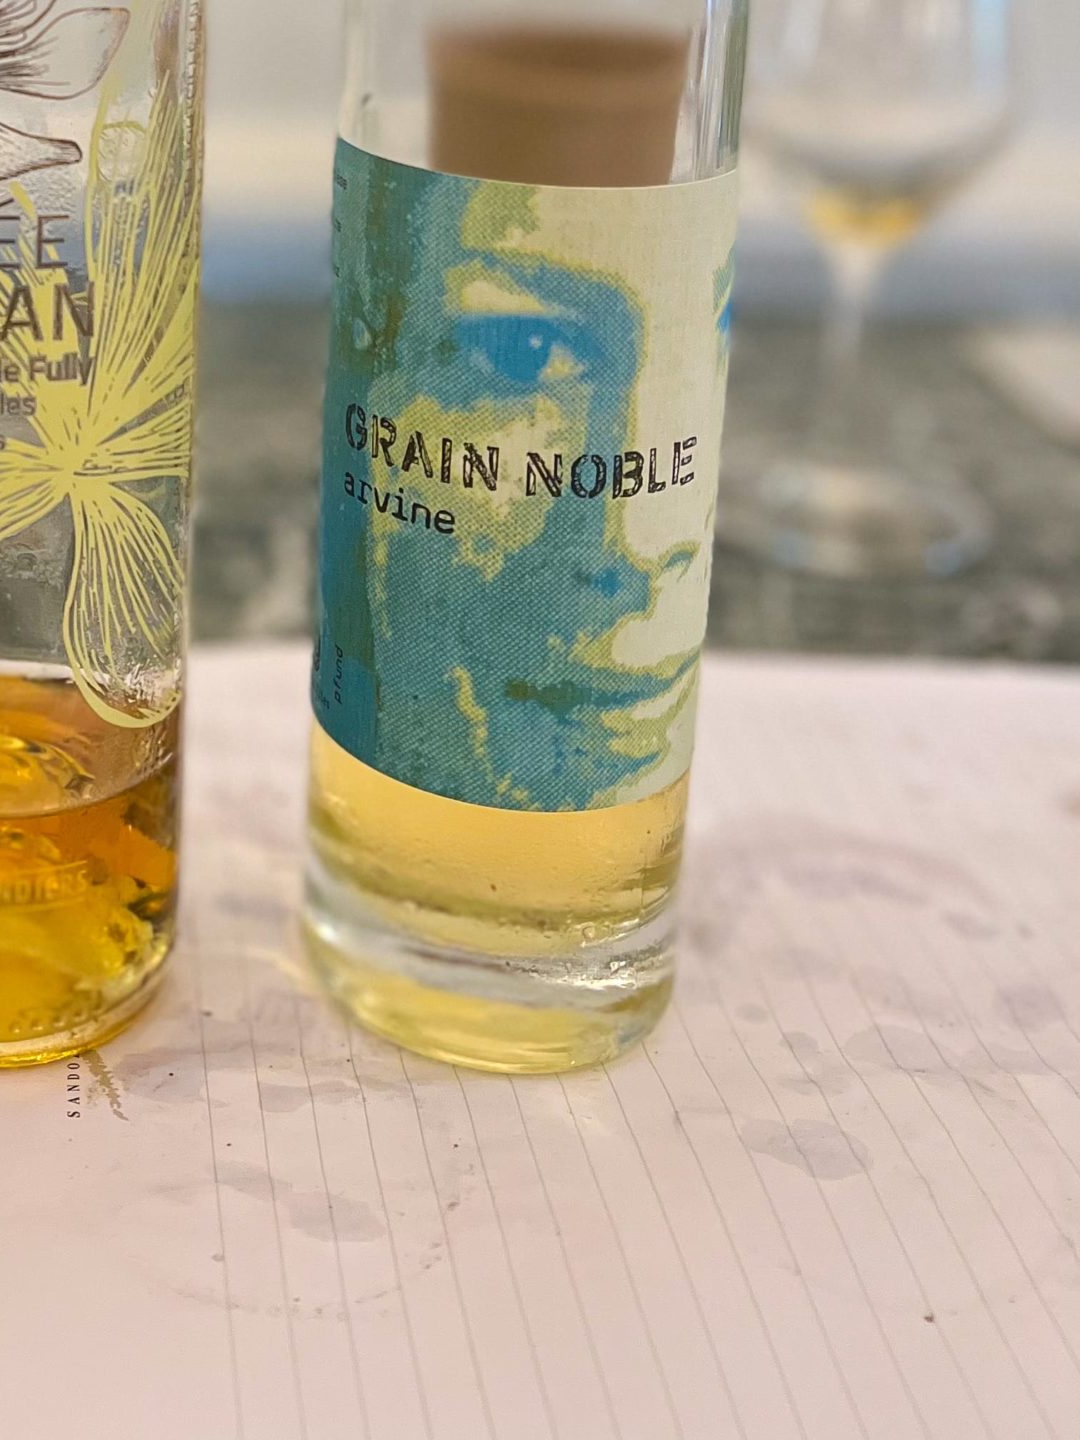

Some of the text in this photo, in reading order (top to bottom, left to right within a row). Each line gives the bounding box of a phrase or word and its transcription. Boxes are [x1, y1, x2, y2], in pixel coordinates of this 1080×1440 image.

[344, 402, 699, 501] GRAIN NOBLE
[342, 470, 456, 536] arvine
[66, 1052, 81, 1119] SANDO
